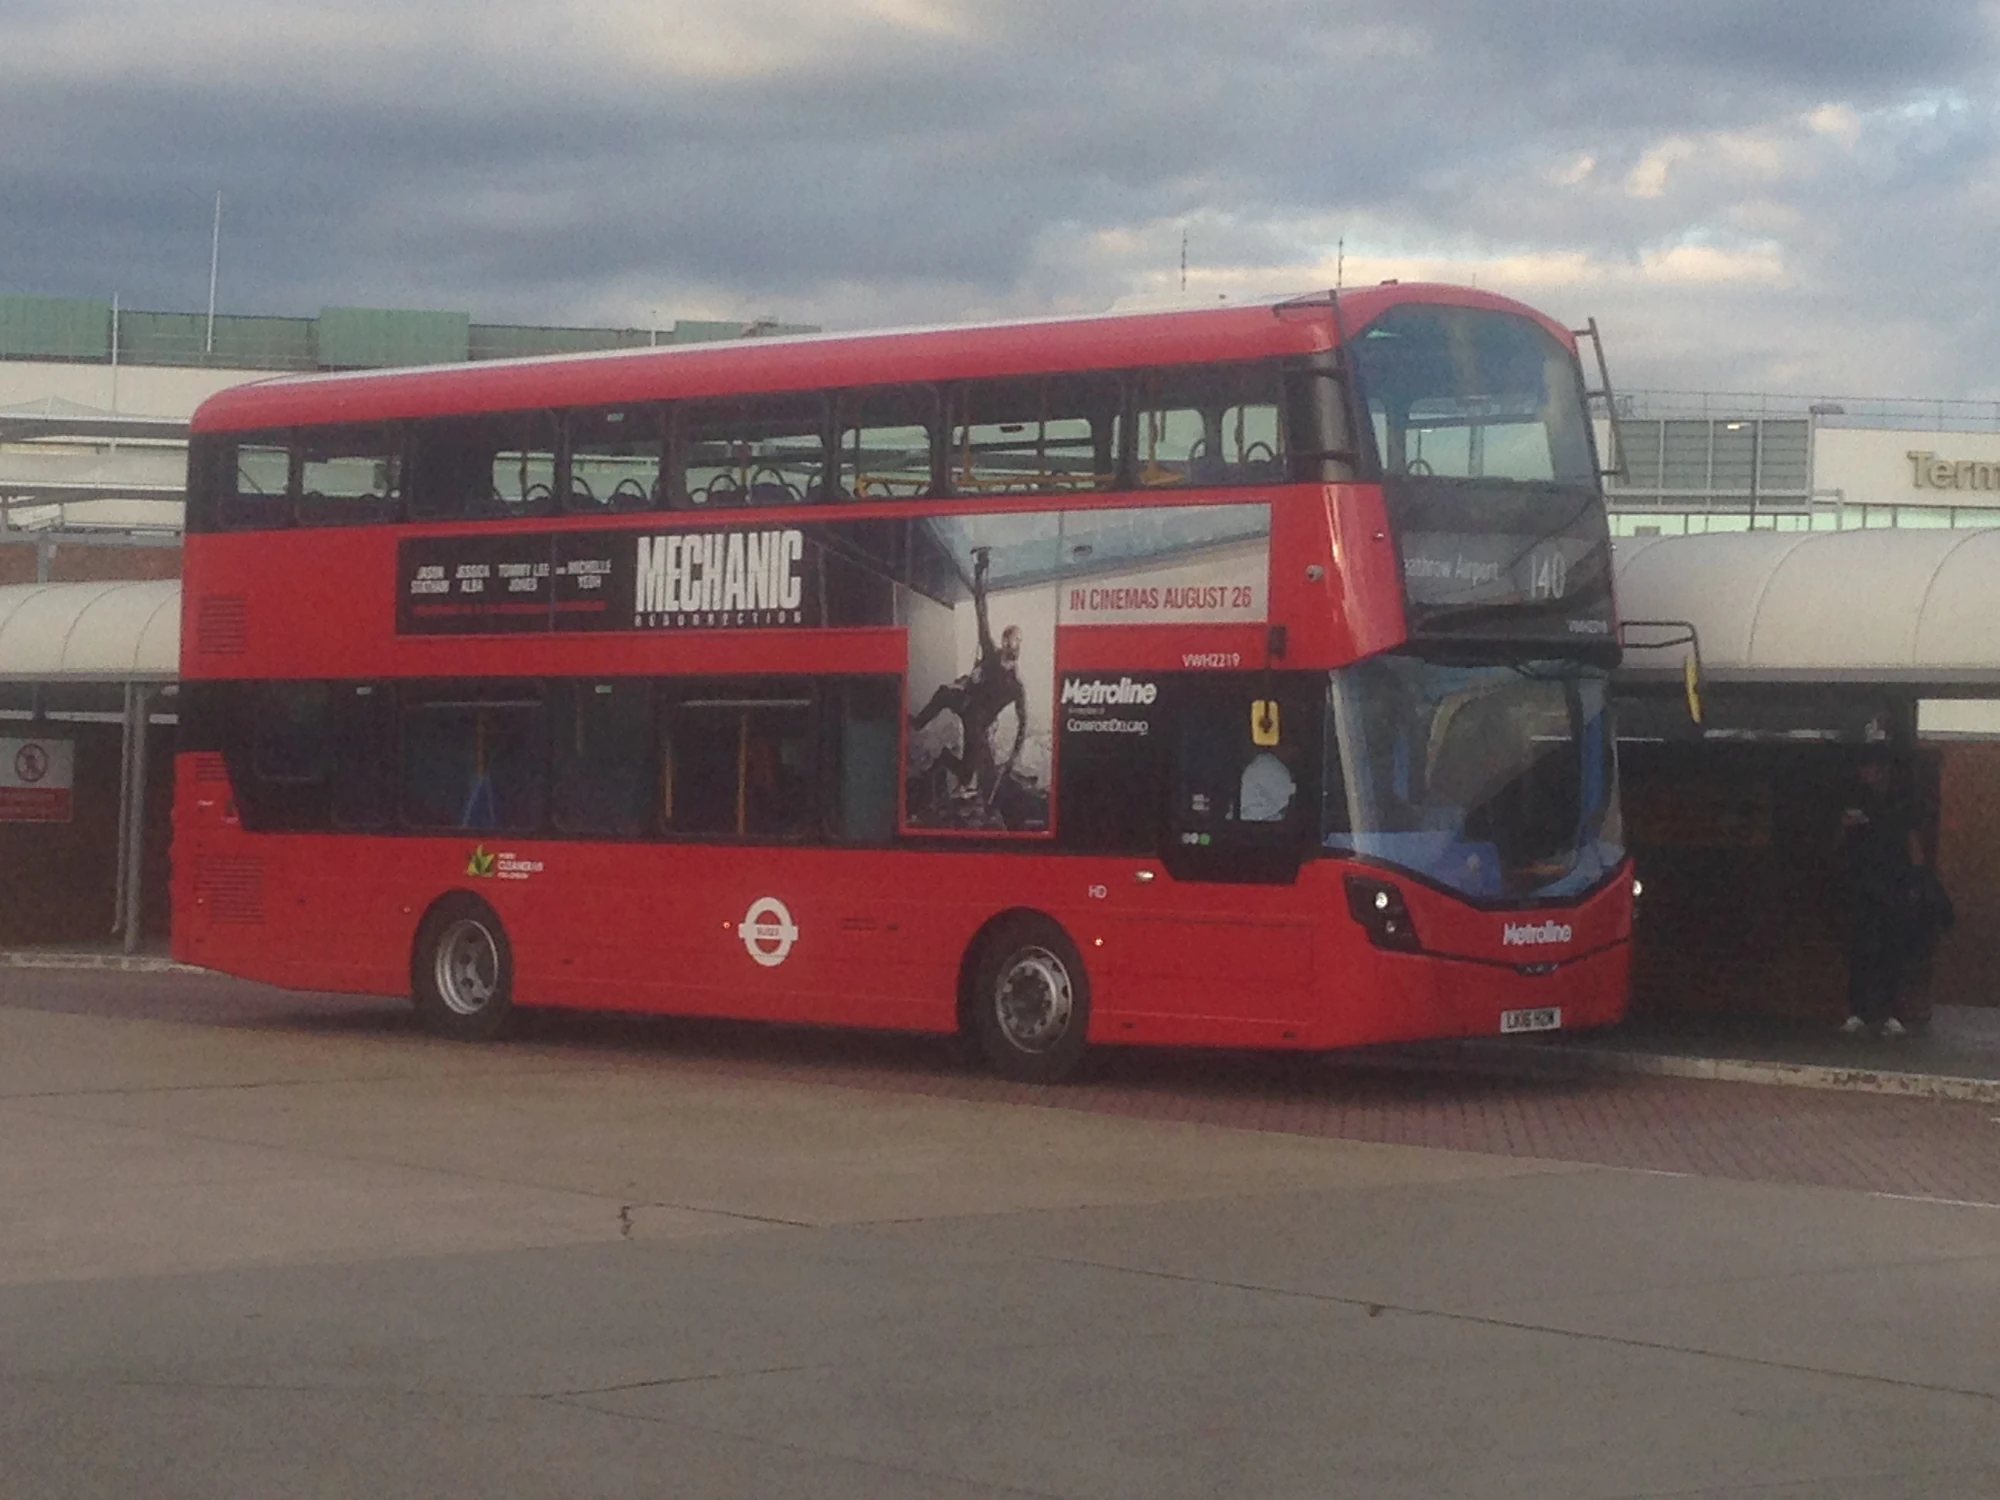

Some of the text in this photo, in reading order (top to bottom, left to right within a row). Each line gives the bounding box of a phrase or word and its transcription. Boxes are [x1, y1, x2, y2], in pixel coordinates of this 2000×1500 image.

[636, 530, 803, 612] MECHANIC
[1531, 551, 1567, 599] 140
[1070, 586, 1252, 611] IN CINEMAS AUGUST 26
[1181, 652, 1241, 668] VWH2219
[1061, 677, 1157, 705] Metroline
[1502, 919, 1572, 945] Metroline
